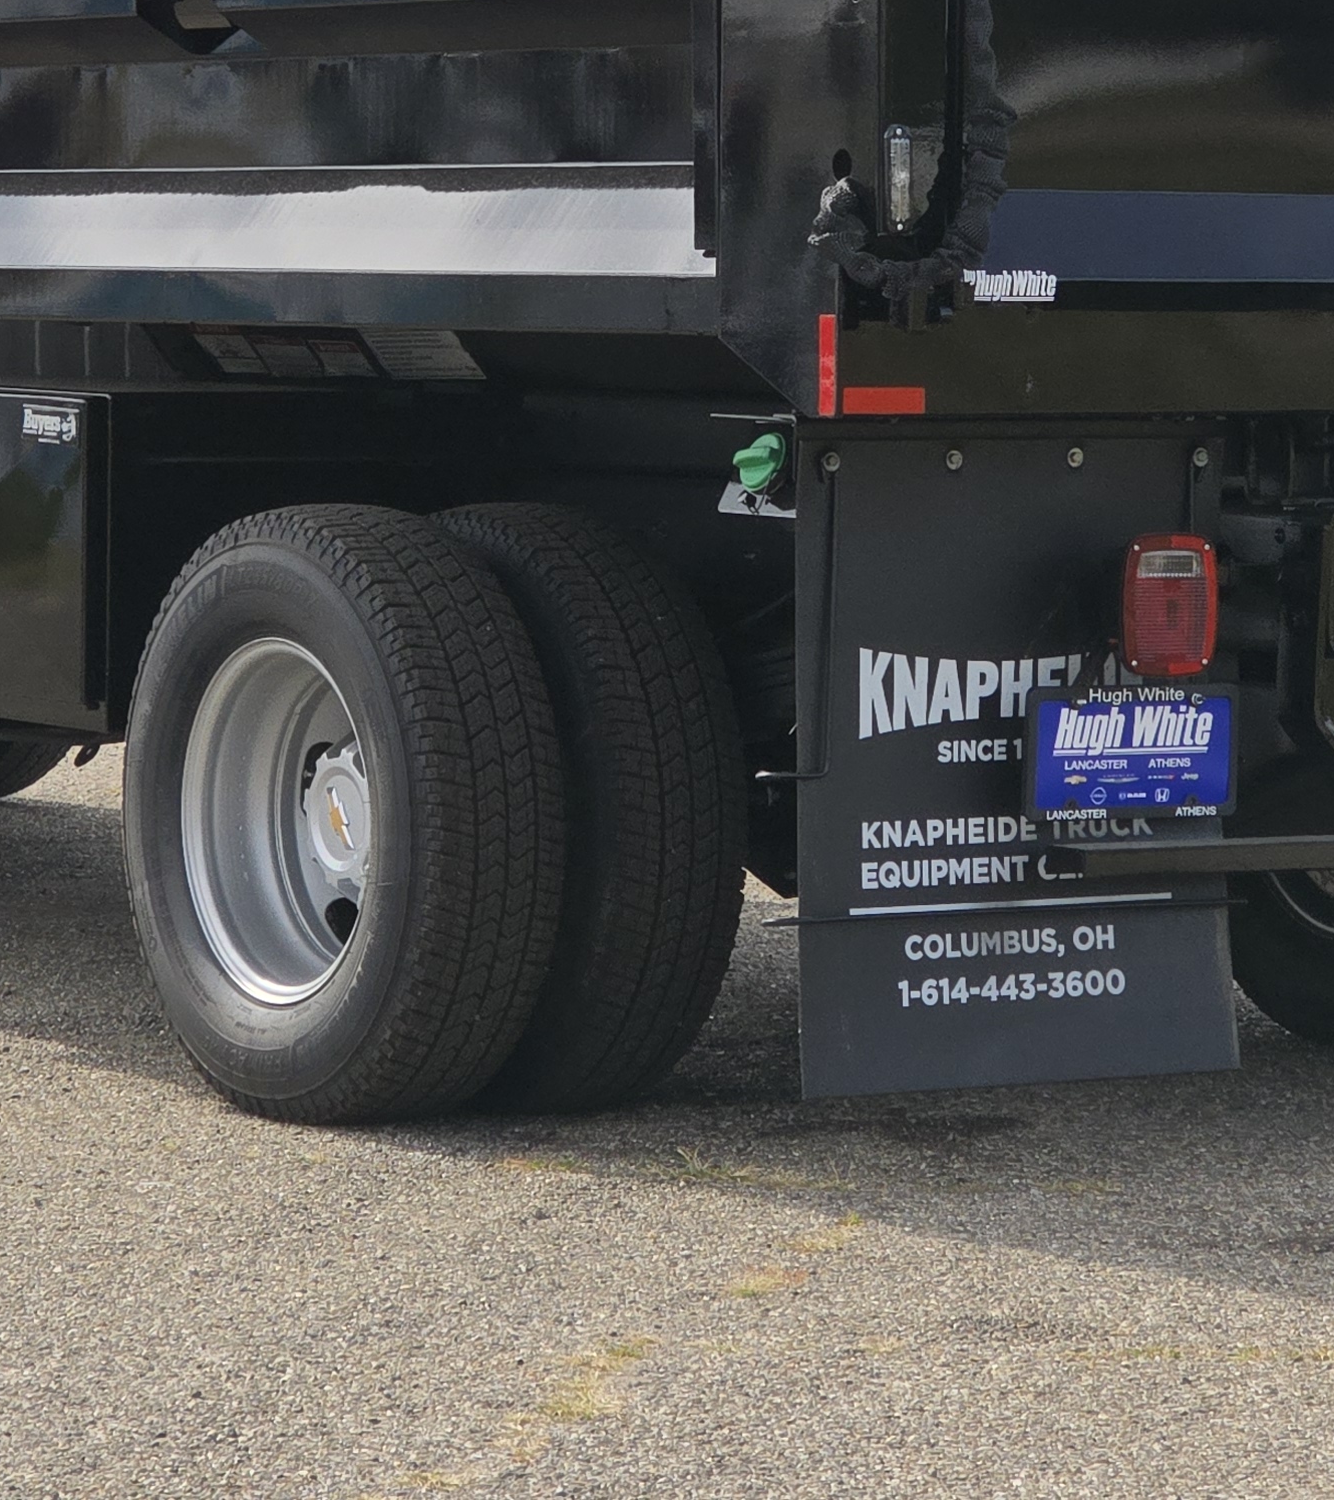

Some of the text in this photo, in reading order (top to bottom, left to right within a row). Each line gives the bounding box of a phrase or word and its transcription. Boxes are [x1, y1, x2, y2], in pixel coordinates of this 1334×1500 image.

[974, 270, 1012, 301] Hugh
[1012, 270, 1057, 296] White
[23, 408, 61, 435] Buyers
[859, 647, 1144, 739] KNAPHE
[1089, 687, 1185, 706] Hugh White
[1054, 707, 1126, 756] Hugh
[1132, 705, 1213, 748] White
[937, 739, 1007, 763] SINCE
[1064, 757, 1191, 771] LANCASTER ATHENS
[1046, 805, 1217, 821] LANCASTER ATHENS
[861, 815, 1038, 849] KNAPHEIDE
[861, 855, 1029, 889] EQUIPMENT
[904, 924, 1115, 960] COLUMBUS, OH
[897, 969, 1125, 1007] 1-614-443-3600
